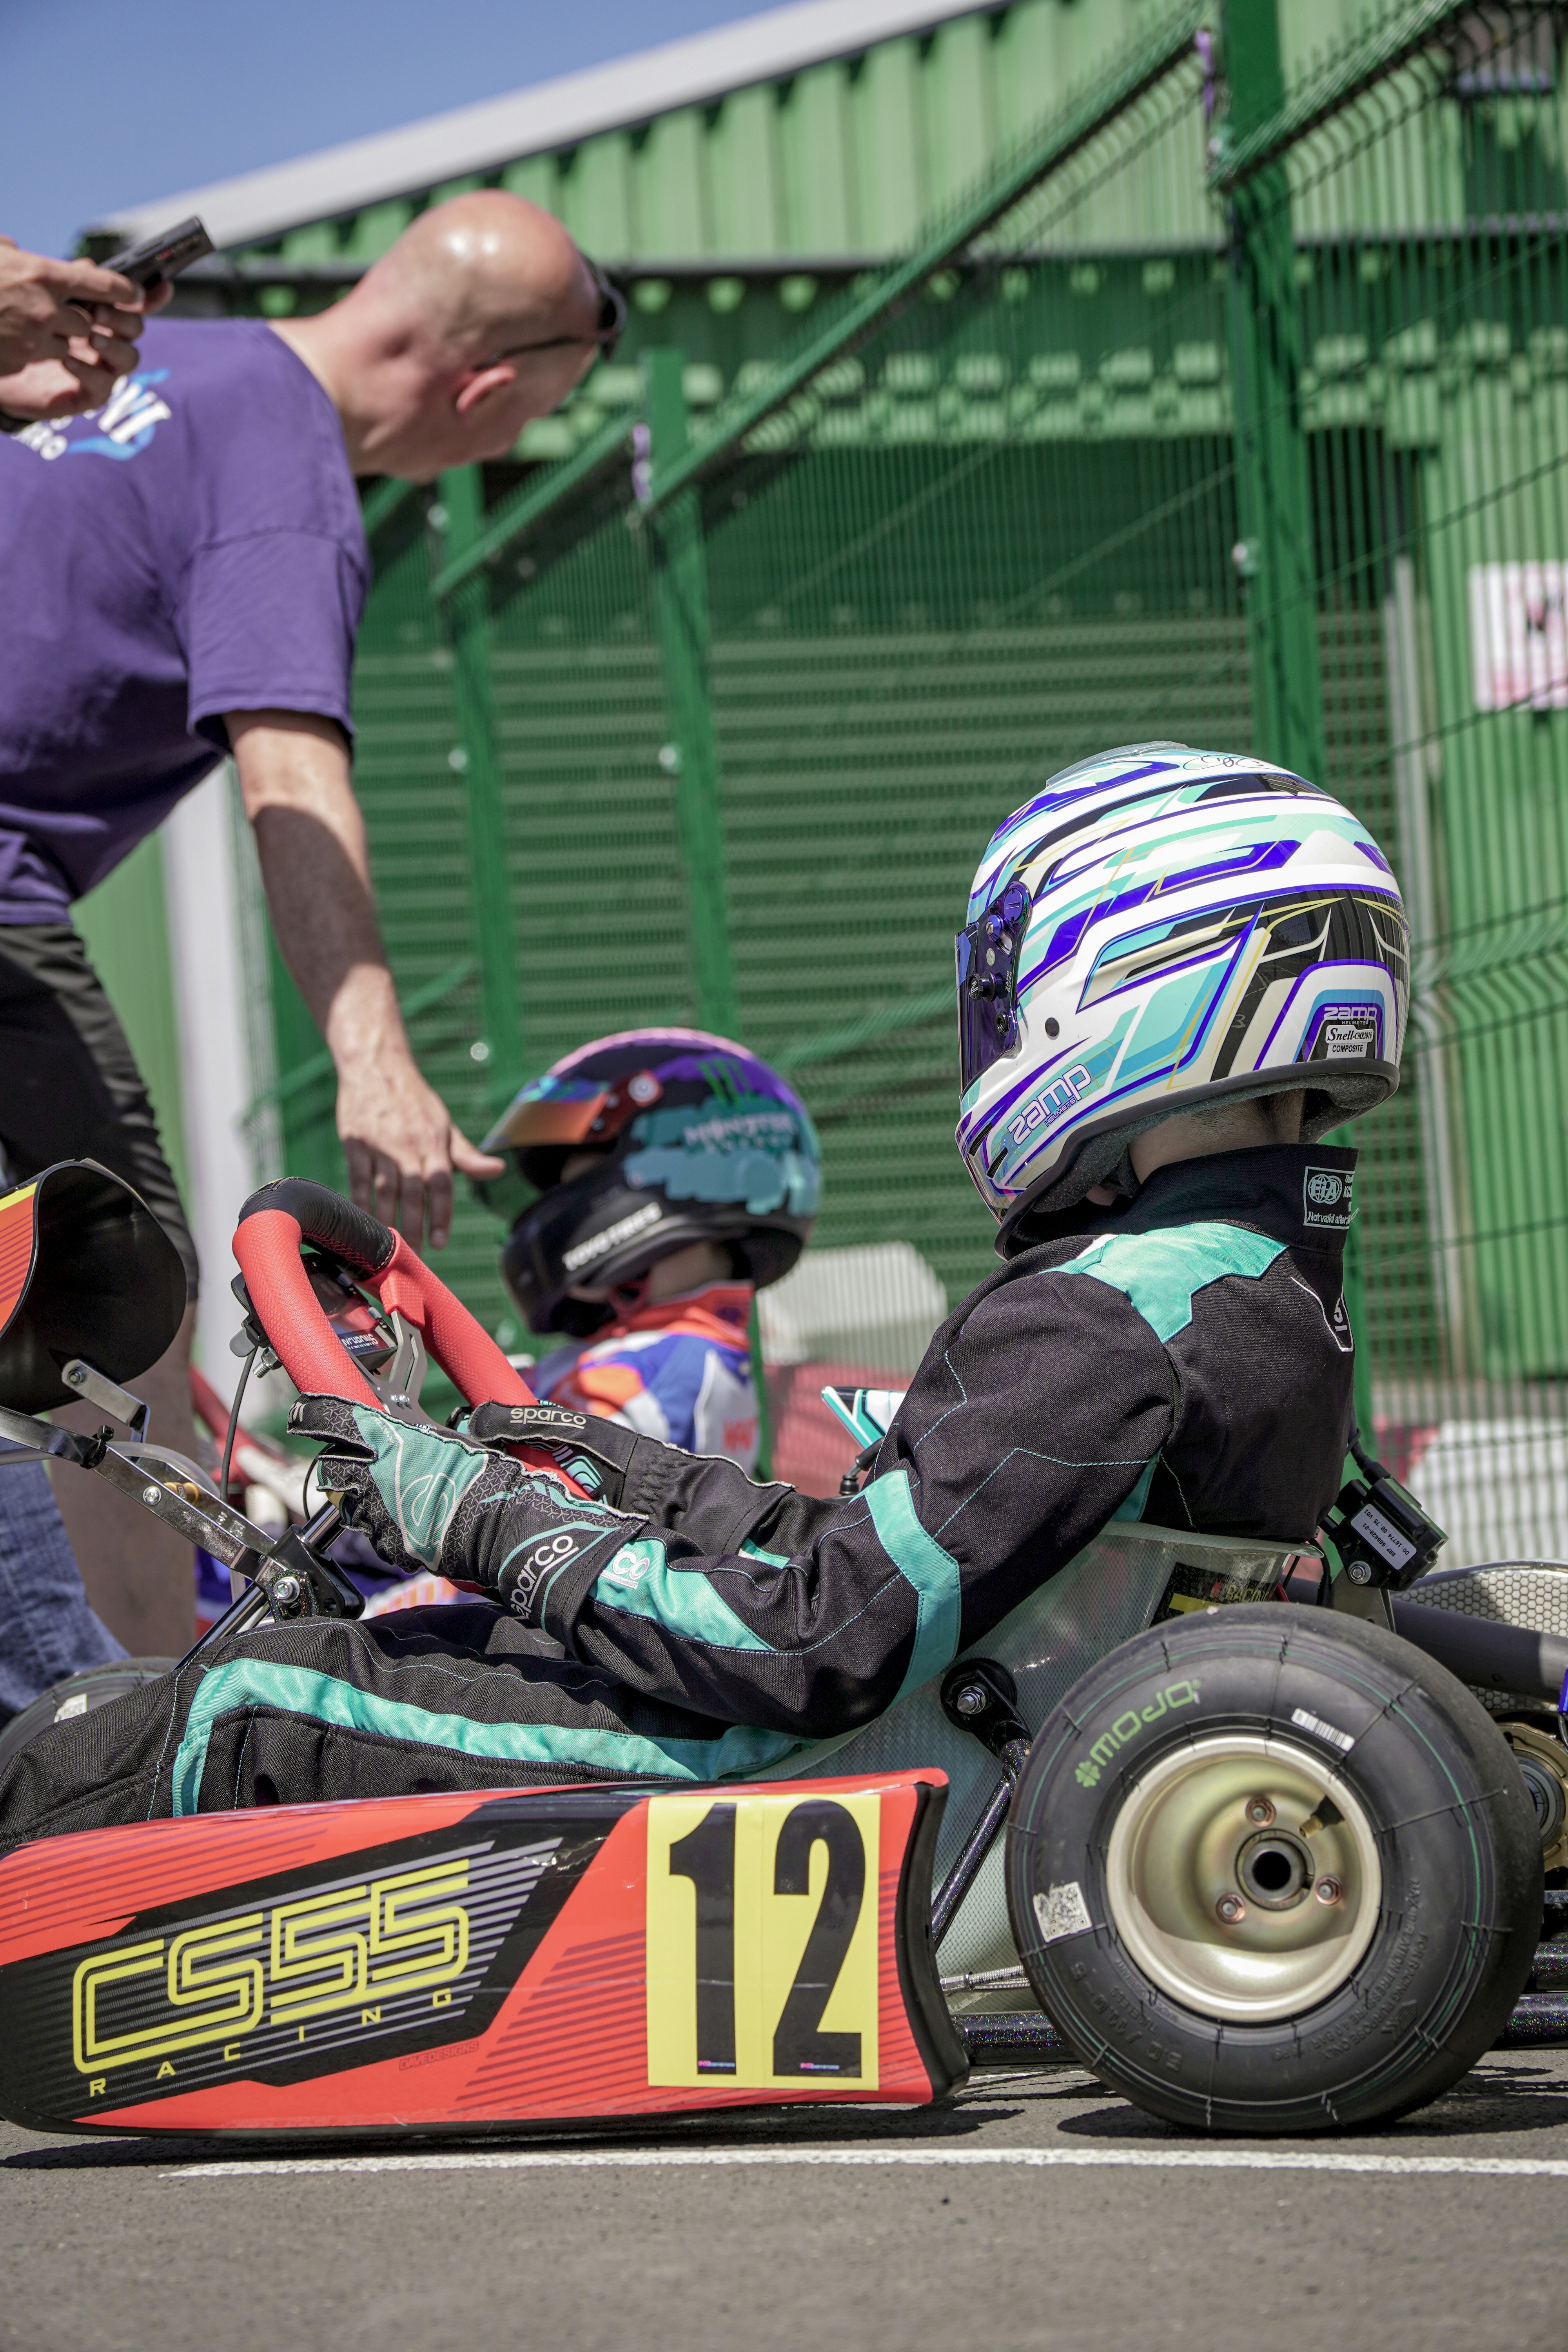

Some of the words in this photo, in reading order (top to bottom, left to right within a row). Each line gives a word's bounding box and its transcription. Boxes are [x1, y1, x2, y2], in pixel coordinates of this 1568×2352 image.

[1324, 1007, 1377, 1025] zamp
[1327, 1027, 1373, 1041] Snell-CMR2016
[1332, 1044, 1364, 1053] COMPOSITE
[1007, 1064, 1091, 1145] zamp
[1044, 1097, 1076, 1127] HELMETS
[1308, 1211, 1320, 1222] Not
[1321, 1213, 1335, 1224] valid
[510, 1408, 586, 1425] sparco
[1364, 1510, 1373, 1519] V01
[1362, 1523, 1396, 1557] BRP:666820-01
[1089, 1681, 1194, 1766] MOJO
[669, 1799, 866, 2078] 12
[73, 1859, 469, 2073] CS55
[89, 1987, 452, 2097] RACING
